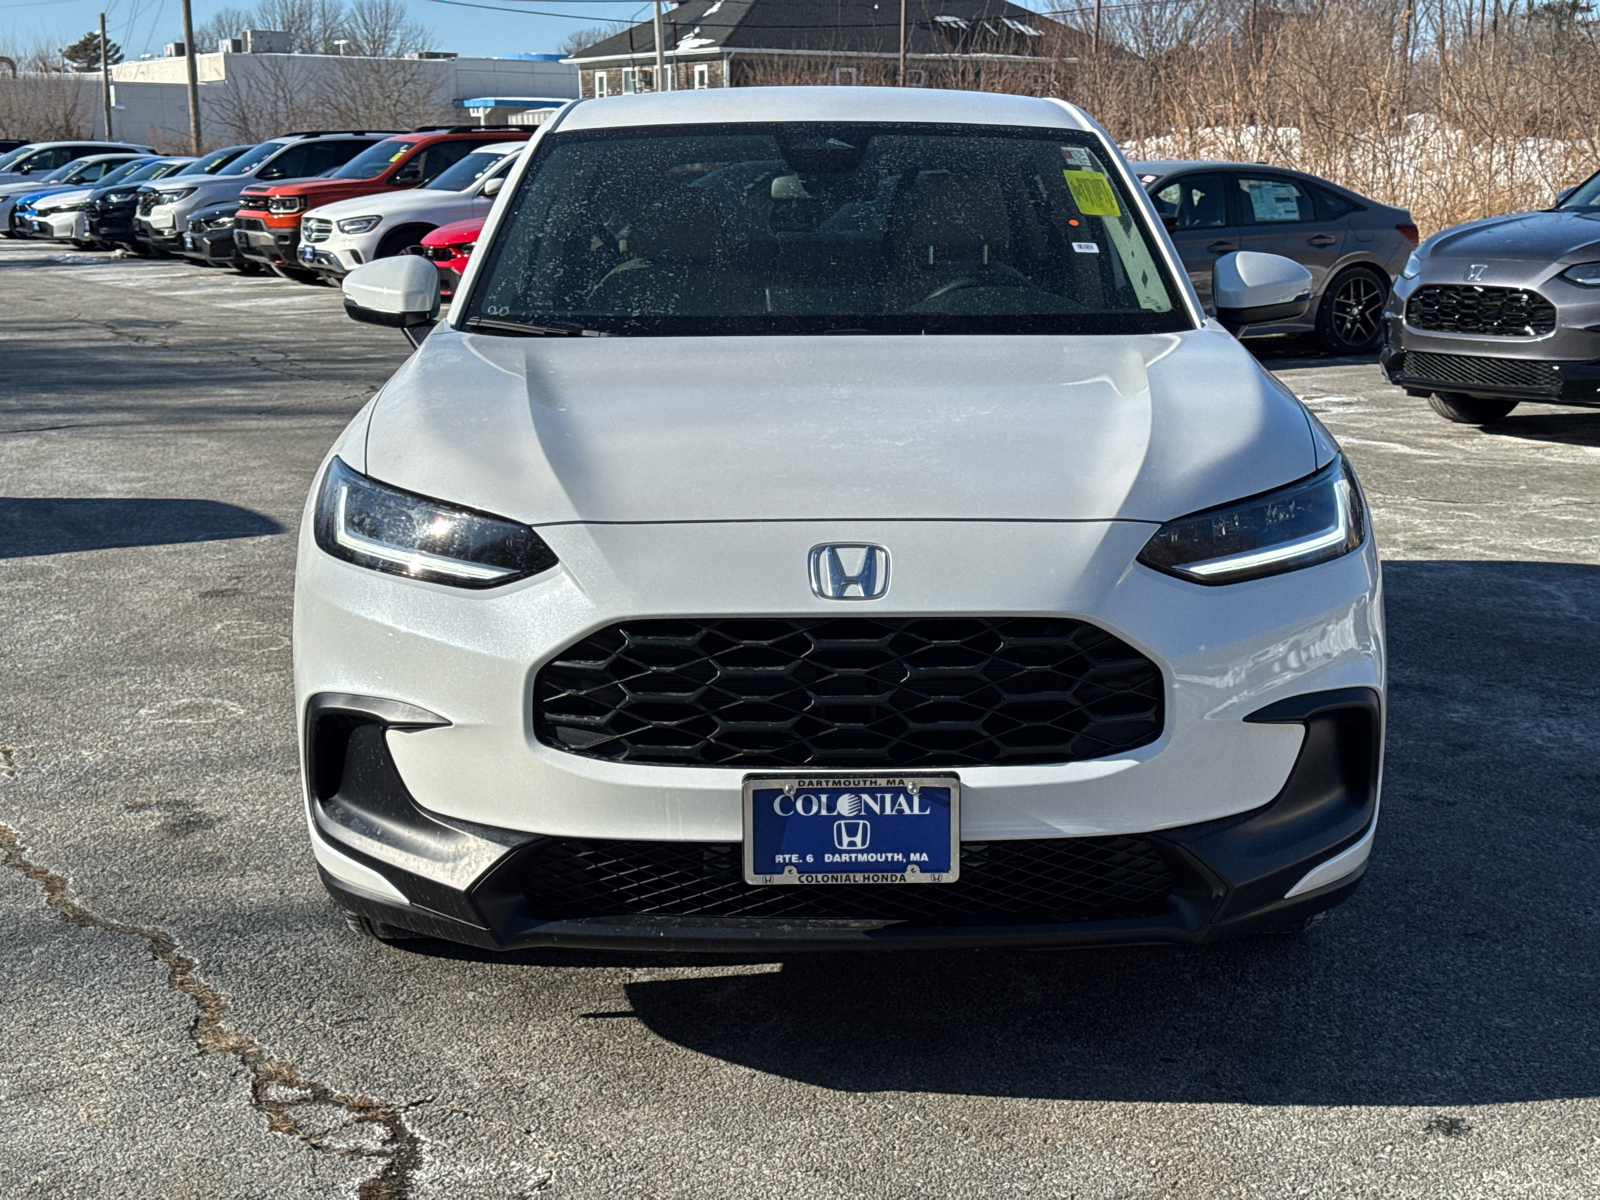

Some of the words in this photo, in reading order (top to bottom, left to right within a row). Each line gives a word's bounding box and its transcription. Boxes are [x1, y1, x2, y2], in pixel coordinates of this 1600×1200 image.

[797, 779, 882, 787] DARTMOUTH,
[886, 778, 905, 786] MA
[773, 792, 931, 817] COLONIAL
[775, 854, 803, 863] RTE.
[806, 854, 814, 863] 6
[824, 853, 907, 863] DARTMOUTH,
[909, 852, 929, 862] MA
[797, 874, 859, 883] COLONIAL
[863, 873, 907, 883] HONDA
